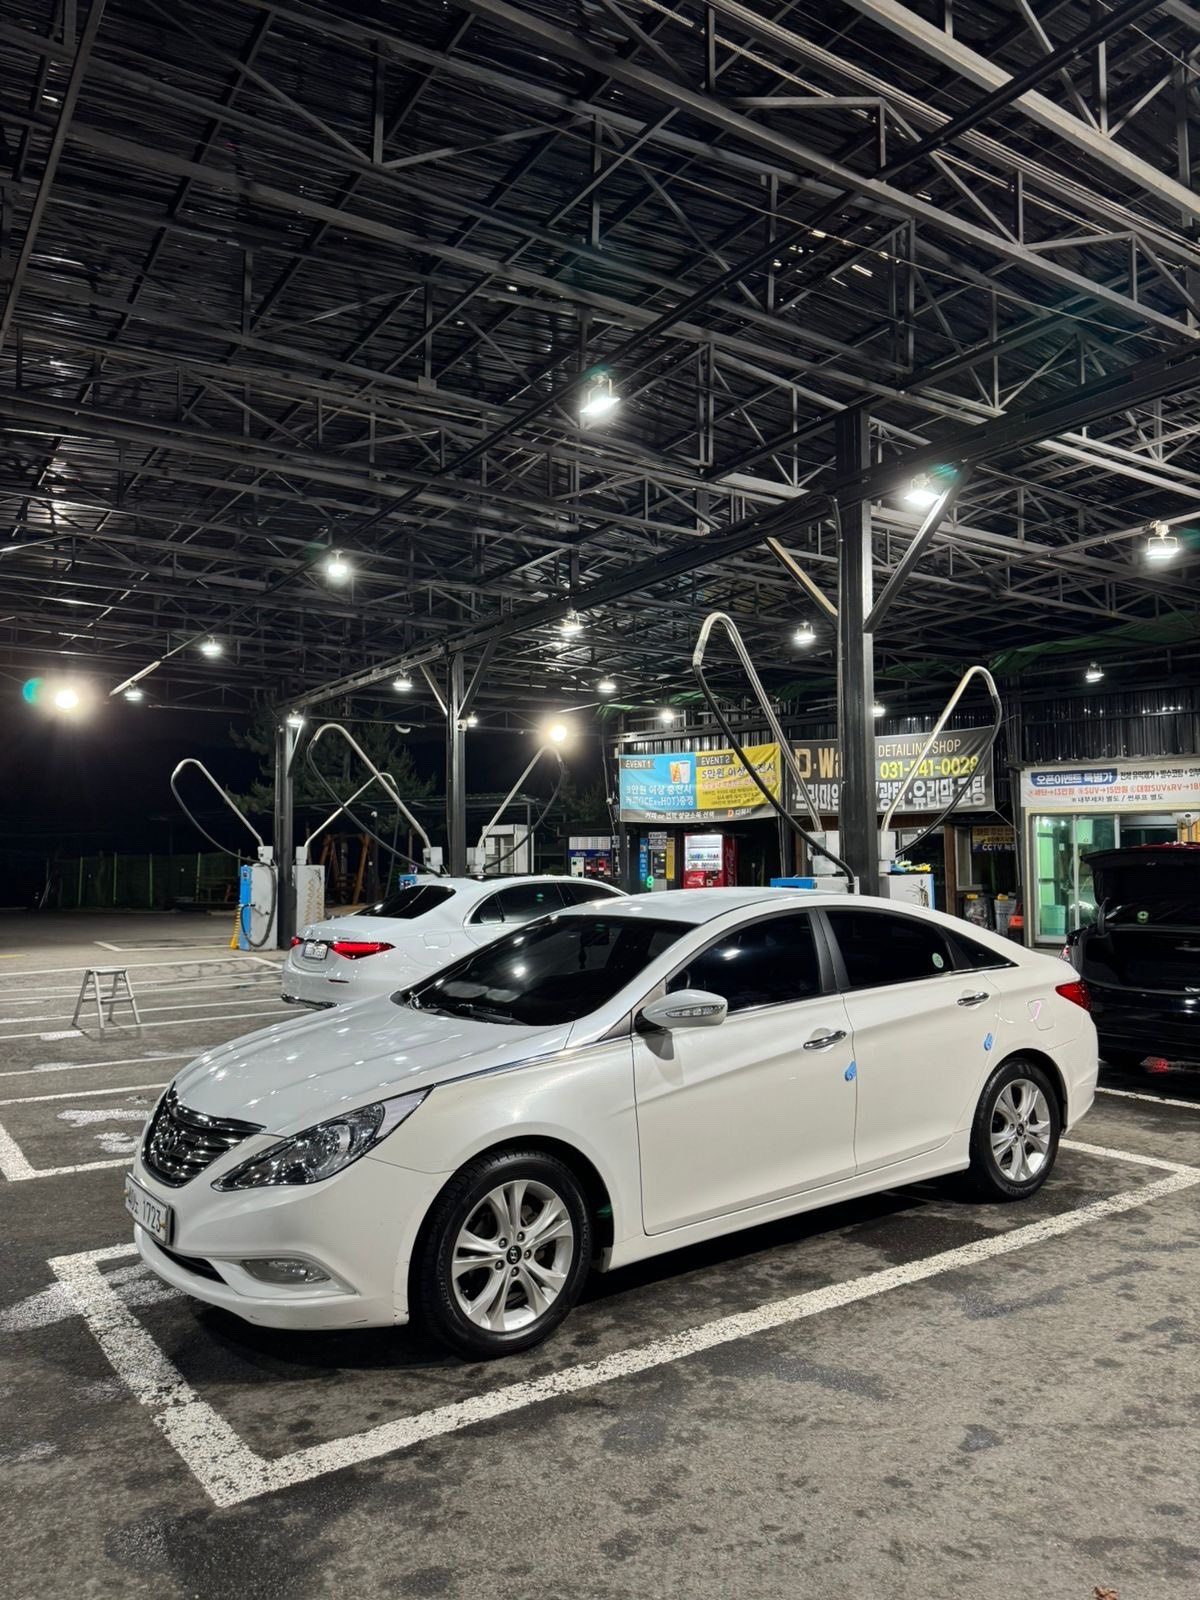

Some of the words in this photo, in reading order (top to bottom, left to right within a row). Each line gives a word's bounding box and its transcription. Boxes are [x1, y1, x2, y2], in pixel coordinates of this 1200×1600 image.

[932, 739, 961, 754] SHOP
[625, 760, 646, 769] EVENT
[647, 760, 651, 768] 1
[701, 756, 723, 766] EVENT
[725, 755, 730, 764] 2
[702, 768, 725, 779] 5만원
[728, 766, 746, 777] 이상
[1036, 773, 1082, 785] 오픈이벤트
[1083, 771, 1113, 783] 특별가
[625, 785, 647, 795] 3만원
[649, 785, 665, 795] 이상
[982, 843, 1003, 851] CCTV
[142, 1199, 161, 1233] 1723
